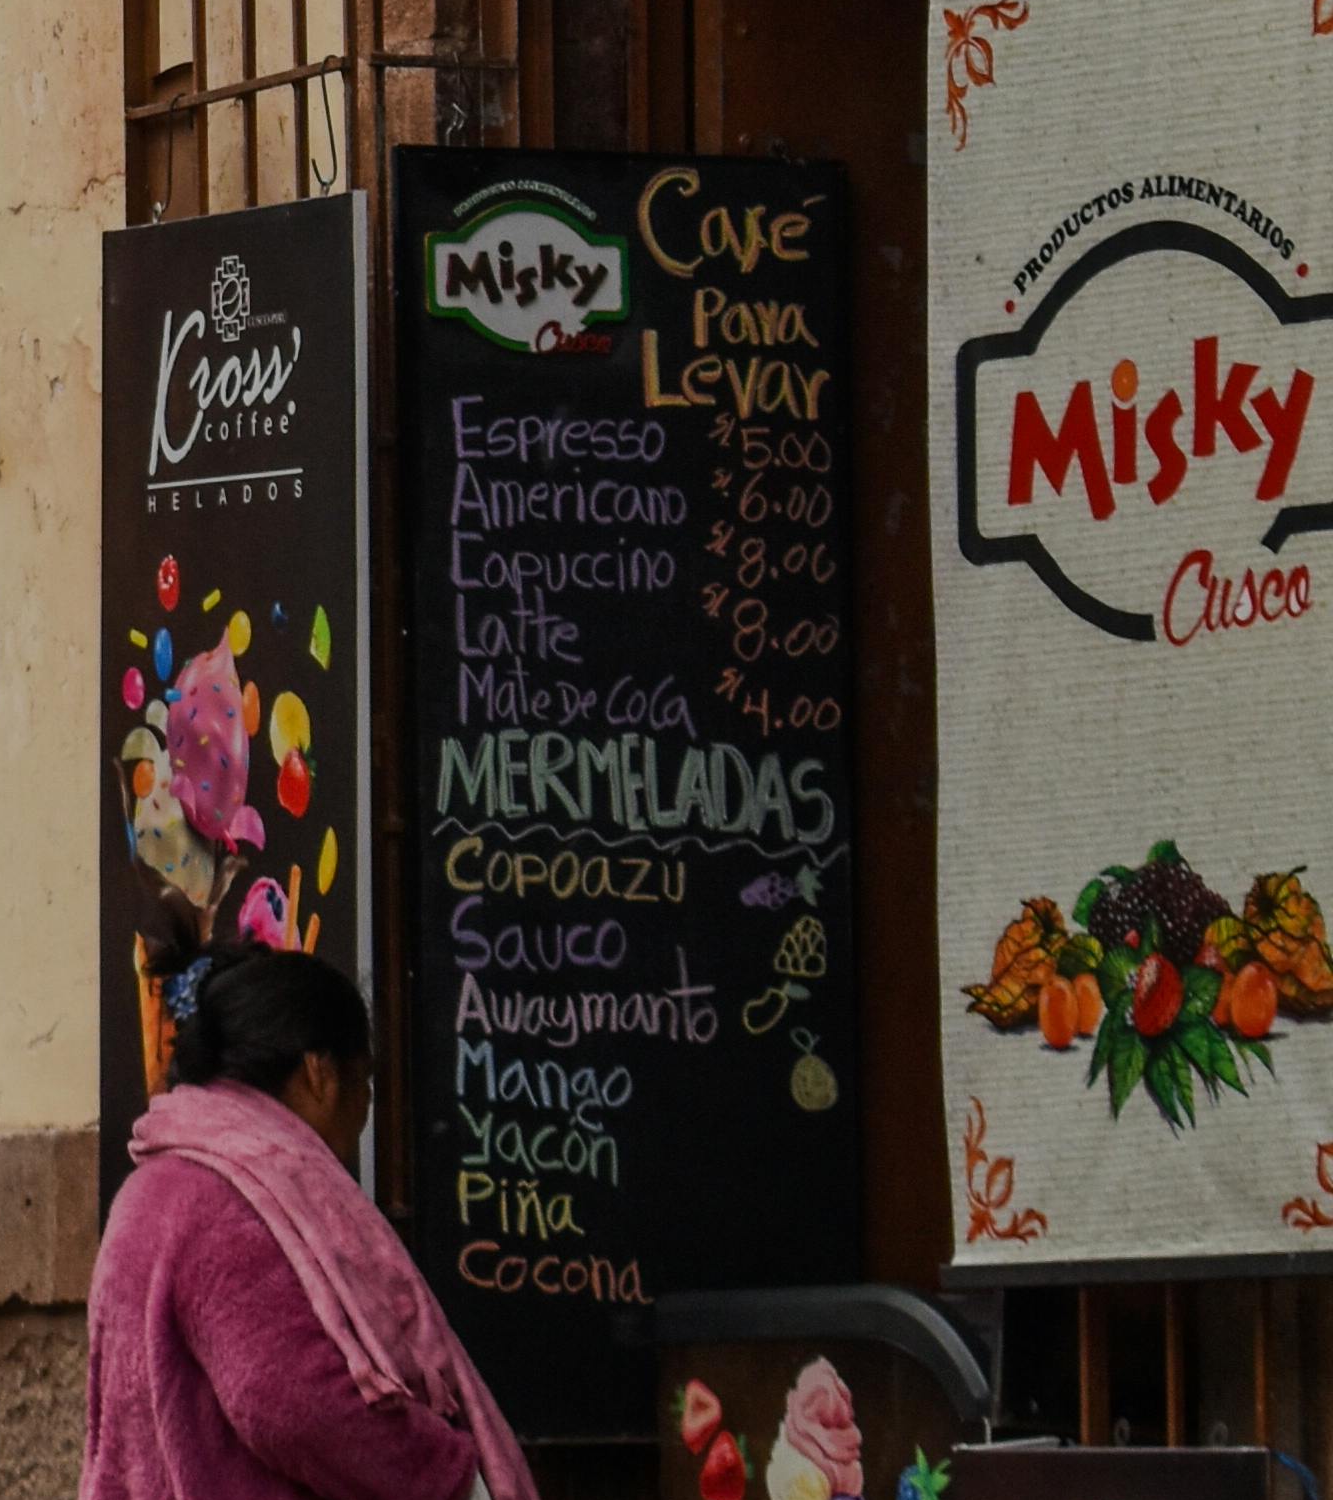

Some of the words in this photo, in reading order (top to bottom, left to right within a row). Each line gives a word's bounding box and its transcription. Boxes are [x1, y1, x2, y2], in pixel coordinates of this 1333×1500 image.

[446, 240, 609, 308] Misky
[1013, 181, 1135, 296] PRODUCTOS
[1138, 174, 1297, 261] ALIMENTARIOS
[204, 410, 290, 443] coffee
[452, 394, 666, 463] Espresso
[739, 426, 833, 473] 5.00
[1008, 336, 1315, 521] Misky
[146, 478, 303, 513] HELADOS
[451, 462, 688, 530] Americano
[739, 471, 834, 529] 6.00
[456, 586, 584, 664] Latte
[733, 597, 840, 663] 8.00
[1163, 549, 1313, 647] Cusco
[458, 654, 549, 727] Mate
[741, 686, 844, 739] 4.00
[436, 728, 835, 846] MERMELADAS
[449, 896, 629, 971] Sauco
[455, 945, 719, 1049] Awaymanto
[456, 1038, 633, 1132] Mango
[457, 1170, 586, 1241] Piña
[457, 1240, 655, 1305] Cocona
